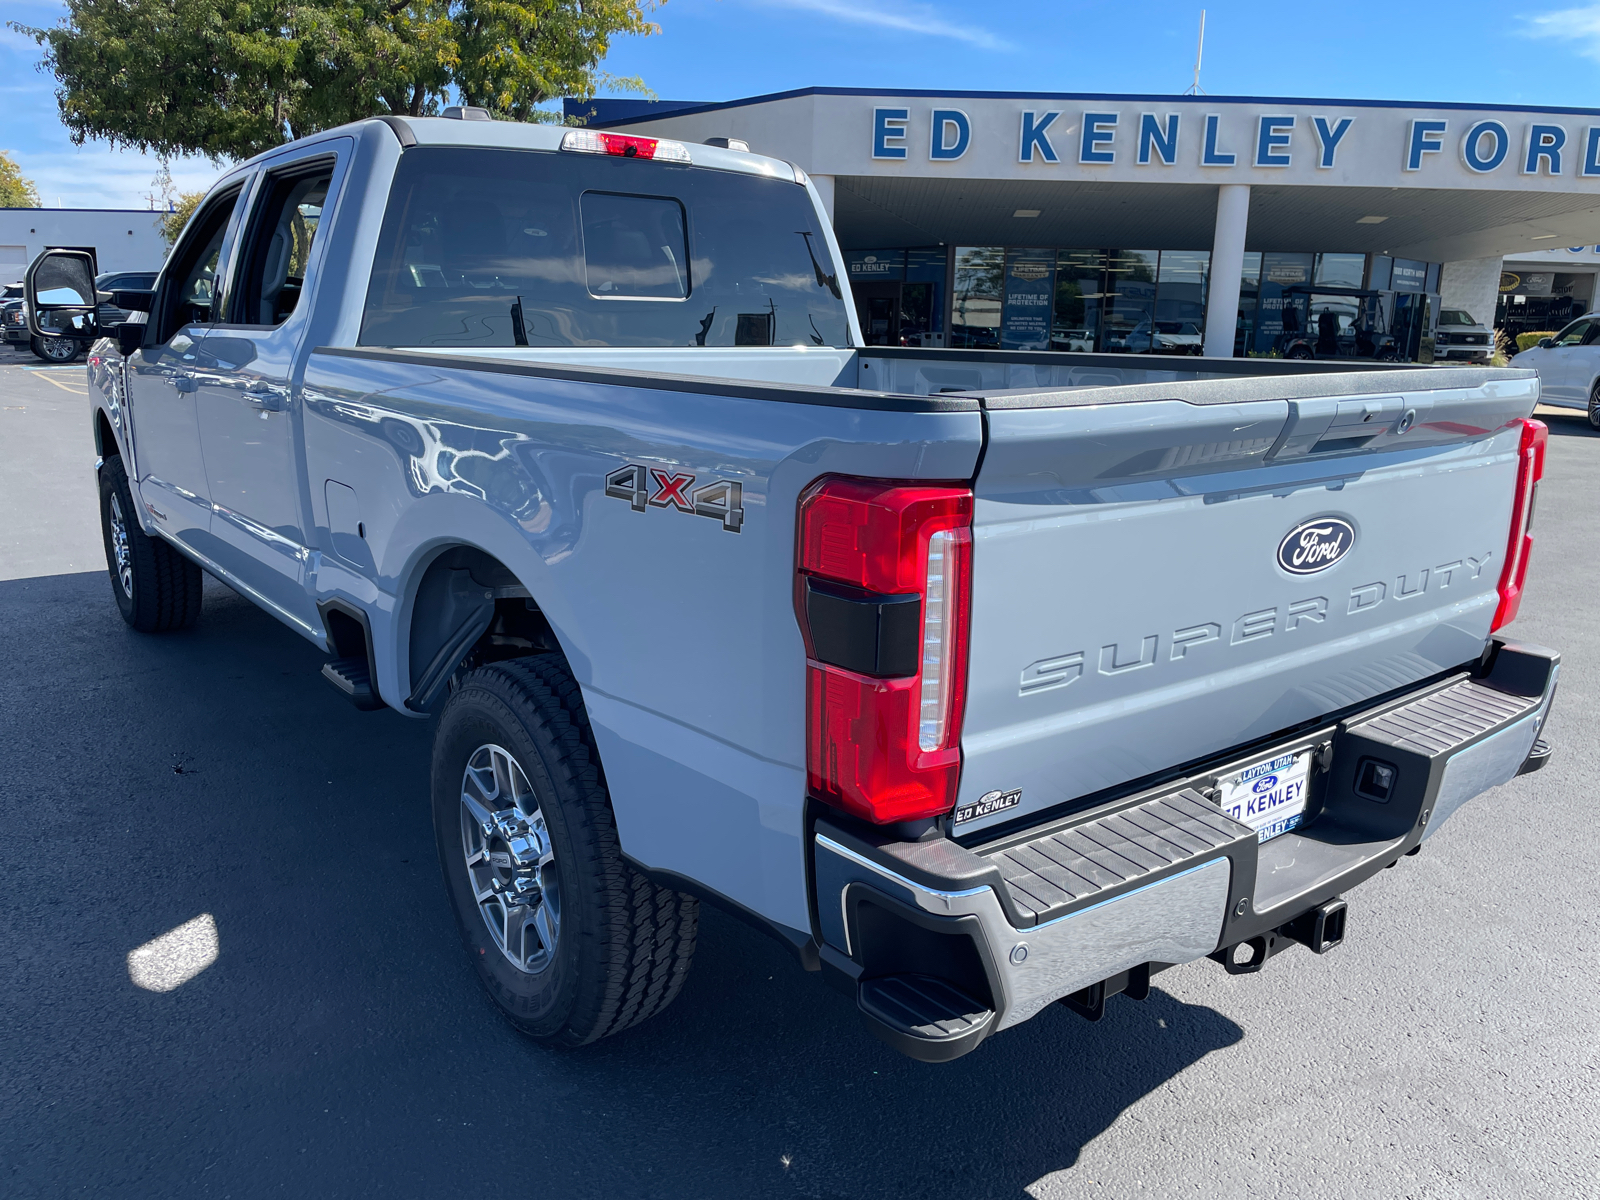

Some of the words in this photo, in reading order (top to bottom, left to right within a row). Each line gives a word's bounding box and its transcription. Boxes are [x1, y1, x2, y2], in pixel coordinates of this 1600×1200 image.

[872, 106, 972, 161] ED
[1018, 109, 1356, 169] KENLEY
[862, 263, 890, 272] KENLEY
[1292, 526, 1344, 566] Ford
[1018, 595, 1329, 698] SUPER
[1346, 550, 1493, 616] DUTY
[1242, 762, 1273, 781] LAYTON,
[1273, 755, 1293, 769] UTAH
[956, 808, 973, 821] ED
[975, 793, 1021, 816] KENLEY
[1246, 780, 1304, 817] KENLEY
[1258, 819, 1288, 842] ENLEY
